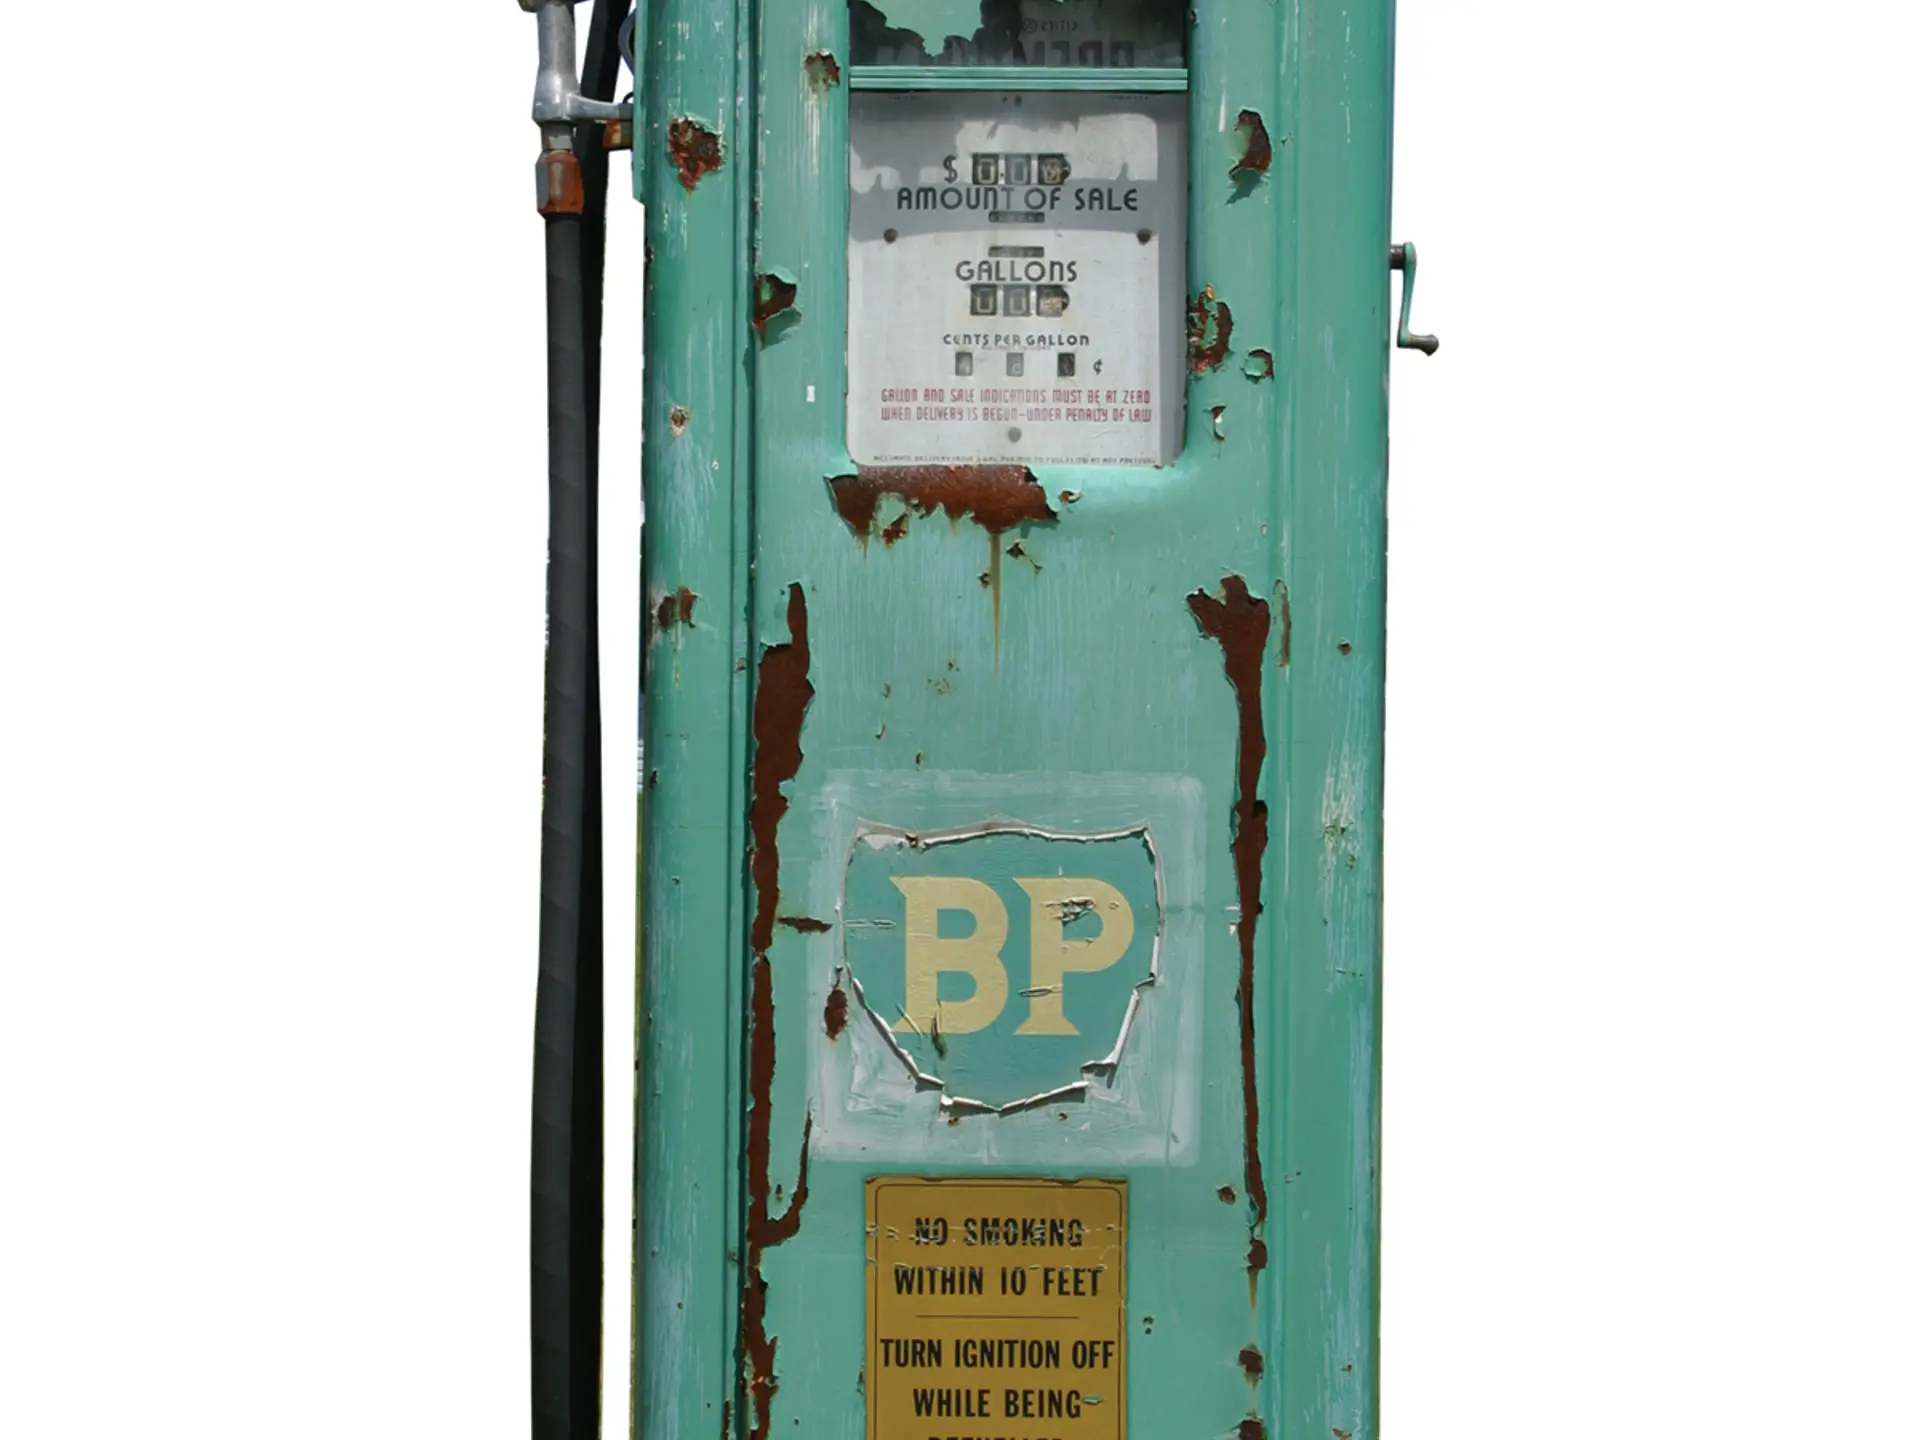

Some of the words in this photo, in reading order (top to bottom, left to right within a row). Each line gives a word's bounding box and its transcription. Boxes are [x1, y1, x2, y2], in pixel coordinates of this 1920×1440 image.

[942, 154, 958, 184] $
[897, 187, 1015, 210] AMOUNT
[1024, 187, 1061, 210] OF
[1075, 188, 1138, 211] SALE
[956, 260, 1077, 282] GALLONS
[943, 333, 989, 346] CENTS
[995, 333, 1021, 346] PER
[1026, 333, 1090, 346] GALLON
[881, 388, 918, 402] GALLON
[923, 388, 945, 402] AND
[950, 388, 975, 403] SALE
[980, 388, 1047, 403] INDICATIONS
[1052, 389, 1082, 403] MUST
[1087, 389, 1100, 404] BE
[1105, 389, 1118, 404] AT
[1123, 389, 1151, 404] ZERO
[881, 406, 911, 421] WHEN
[916, 406, 964, 421] DELIVERY
[967, 406, 979, 421] IS
[1066, 408, 1108, 422] PENALTY
[1112, 408, 1125, 422] OF
[1129, 408, 1152, 422] LAW
[889, 876, 1134, 1036] BP
[915, 1217, 948, 1246] NO
[963, 1217, 1083, 1248] SMOKING
[894, 1265, 984, 1295] WITHIN
[1000, 1266, 1027, 1296] 10
[1043, 1267, 1103, 1297] FEET
[880, 1338, 942, 1368] TURN
[954, 1339, 1060, 1368] IGNITION
[1072, 1340, 1115, 1369] OFF
[913, 1388, 991, 1418] WHILE
[1004, 1389, 1081, 1419] BEING
